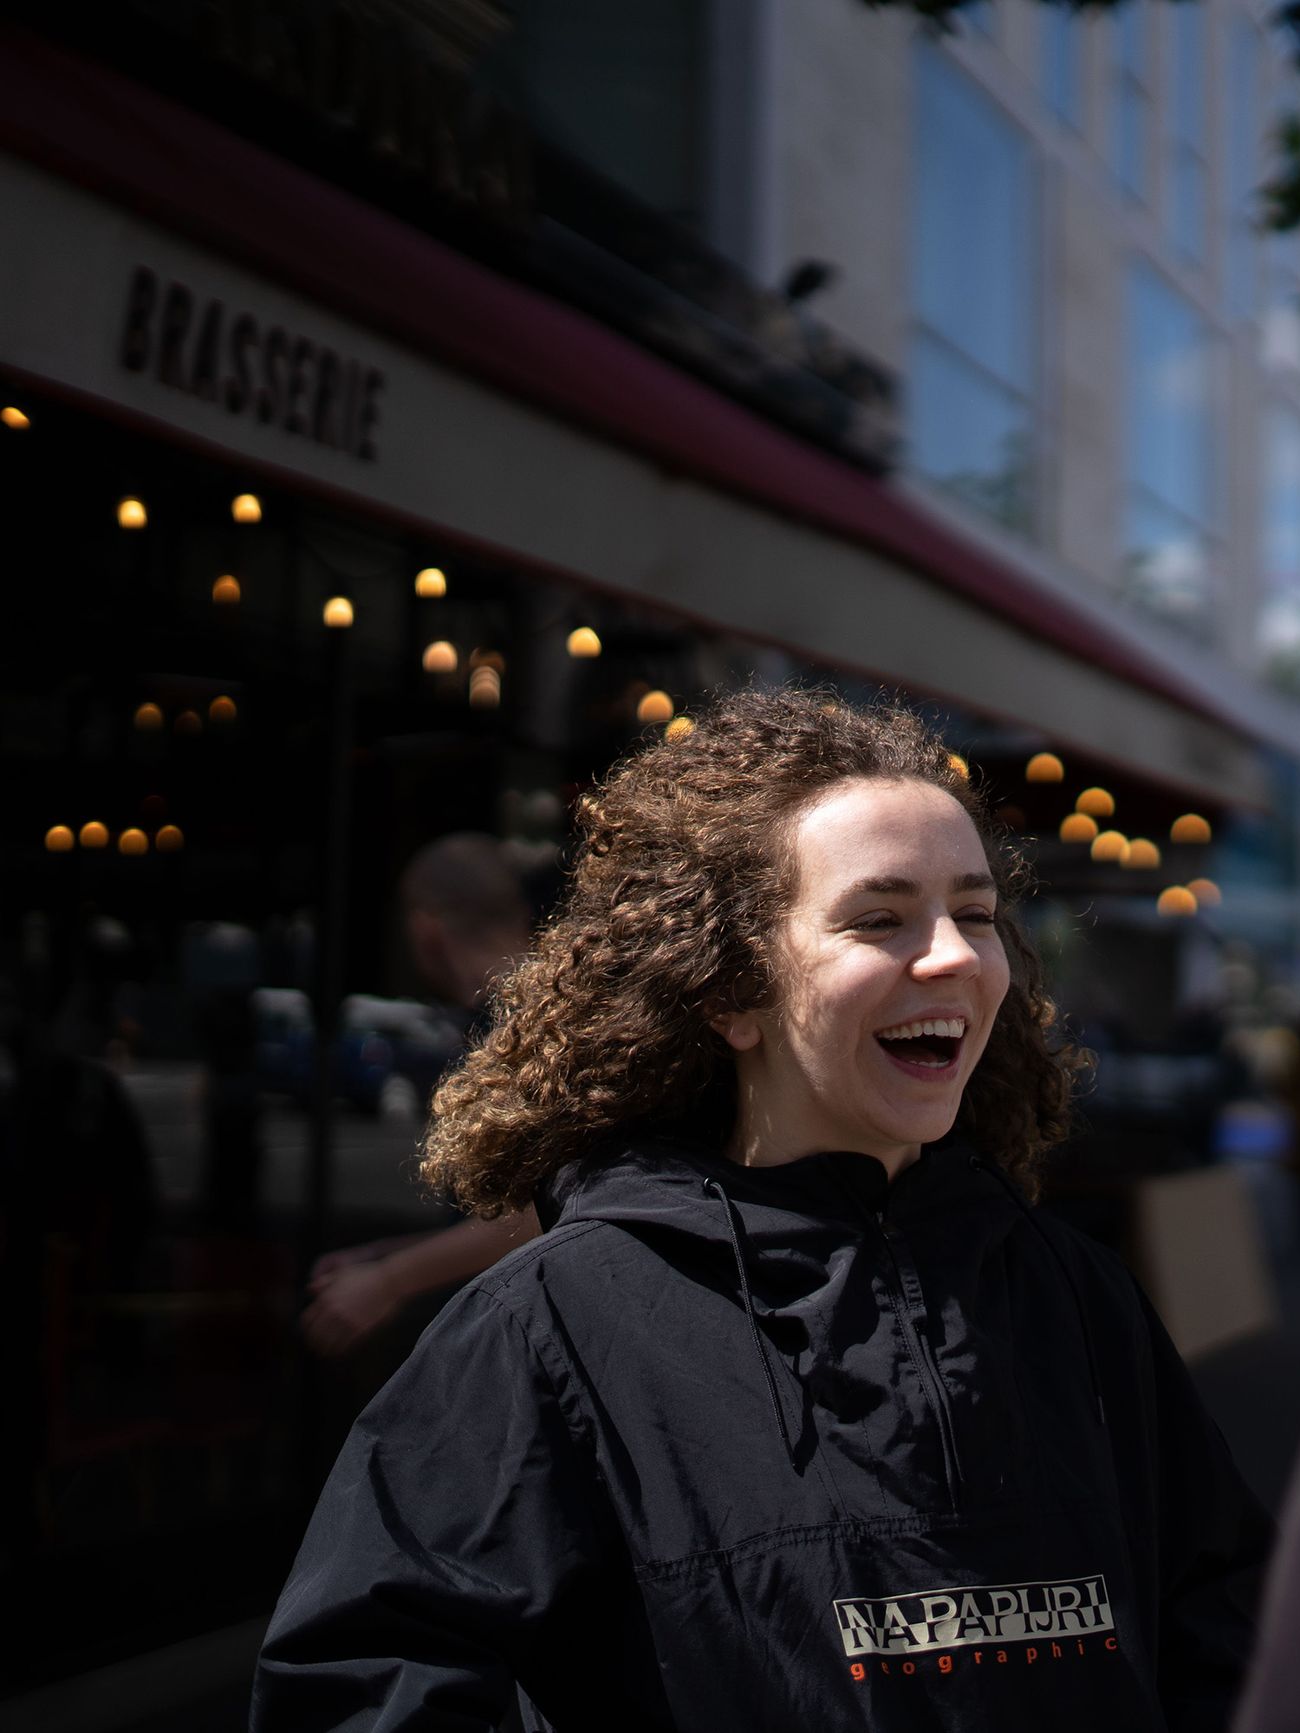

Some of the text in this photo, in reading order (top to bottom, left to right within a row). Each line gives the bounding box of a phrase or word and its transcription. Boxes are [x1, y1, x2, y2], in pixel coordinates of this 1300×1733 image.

[121, 264, 385, 461] BRASSERIE
[841, 1582, 1106, 1649] NAPAPIJRI
[850, 1637, 1118, 1680] geographic
